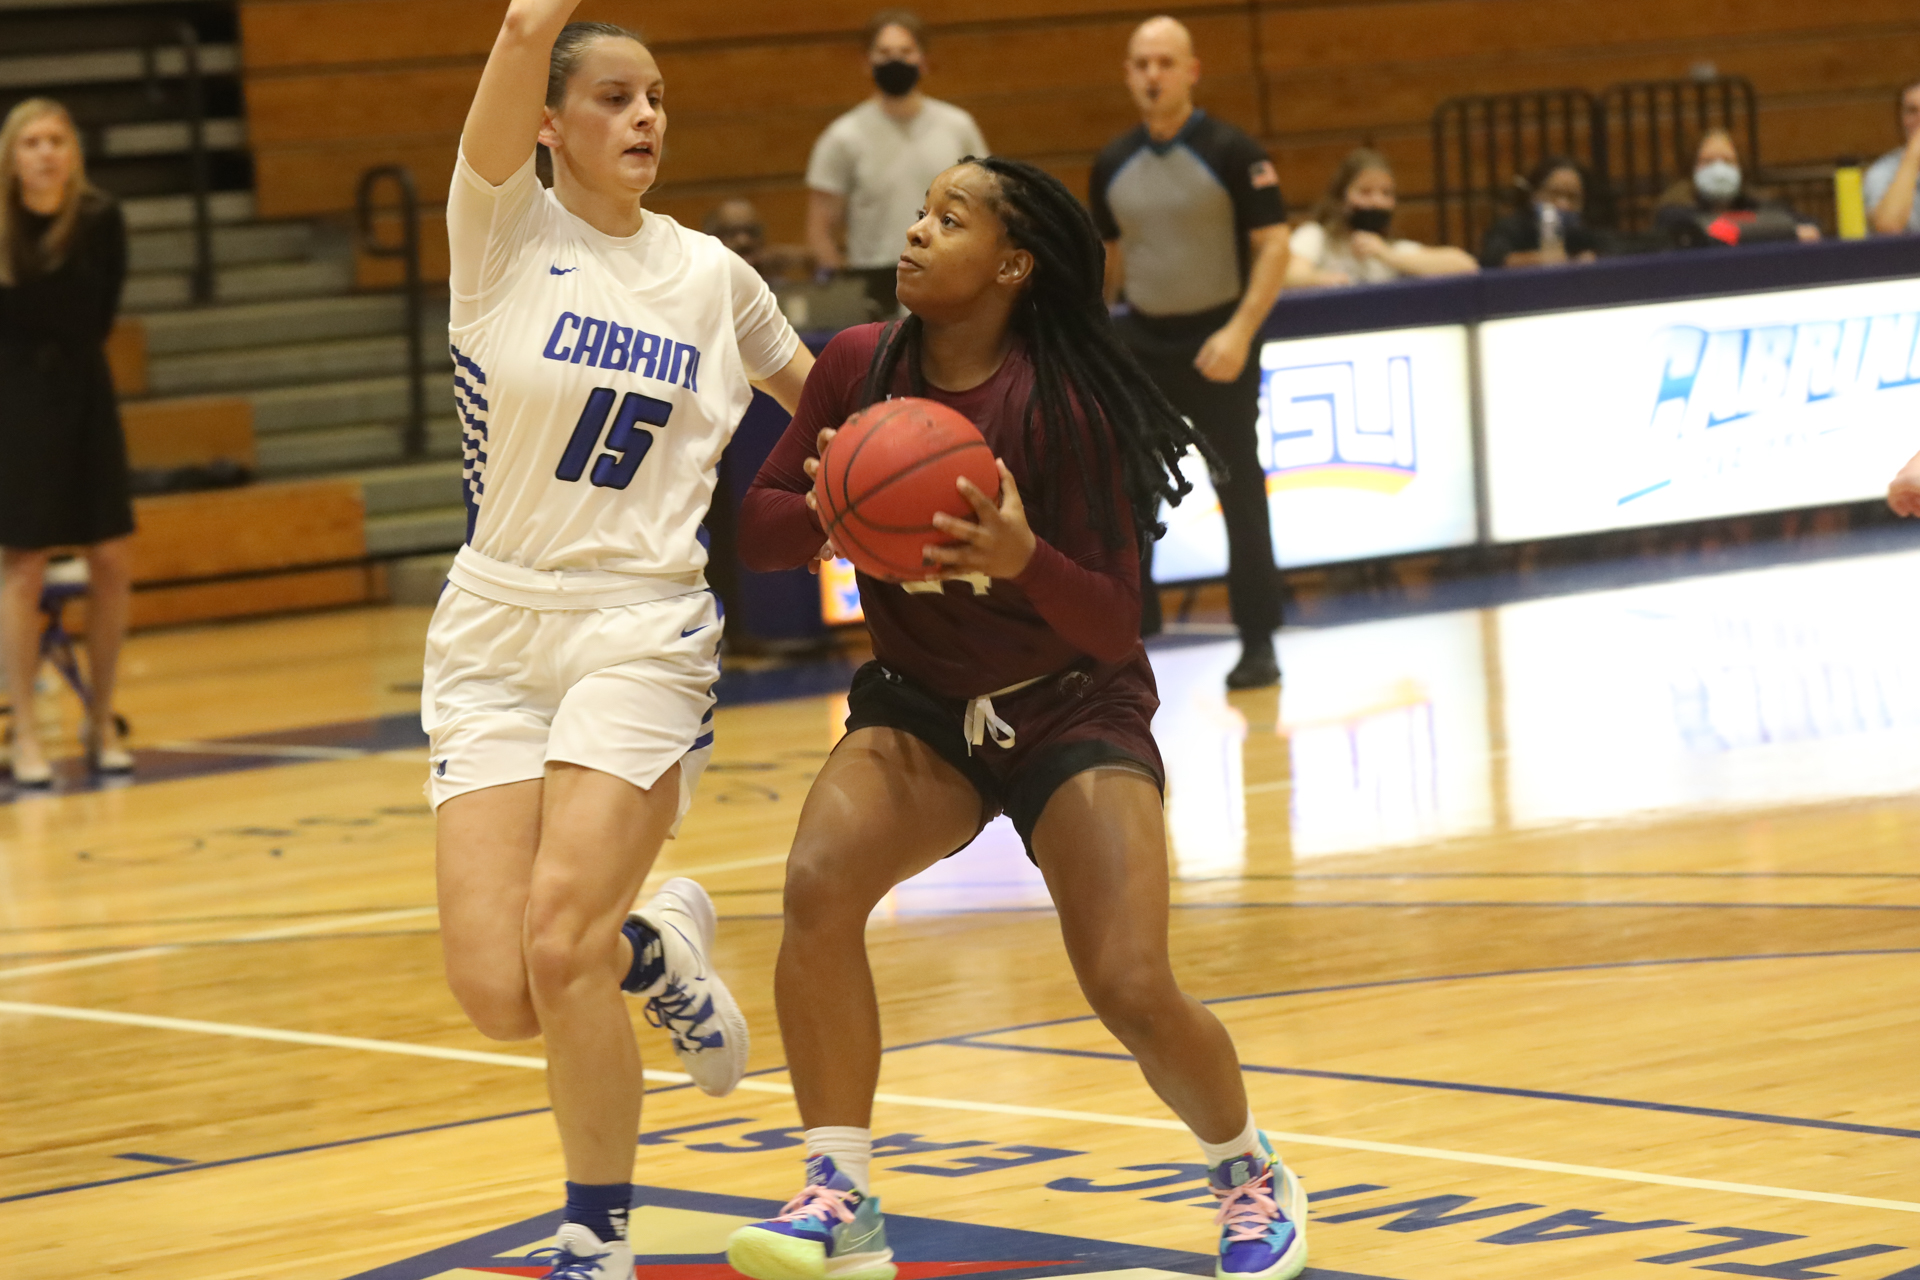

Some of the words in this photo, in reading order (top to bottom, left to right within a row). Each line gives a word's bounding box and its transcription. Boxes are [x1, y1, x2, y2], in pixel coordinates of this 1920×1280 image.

[543, 311, 701, 393] CABRINI
[1650, 312, 1920, 440] CABRIN
[555, 386, 673, 491] 15
[1261, 355, 1418, 474] SU
[1045, 1162, 1920, 1280] TLANC
